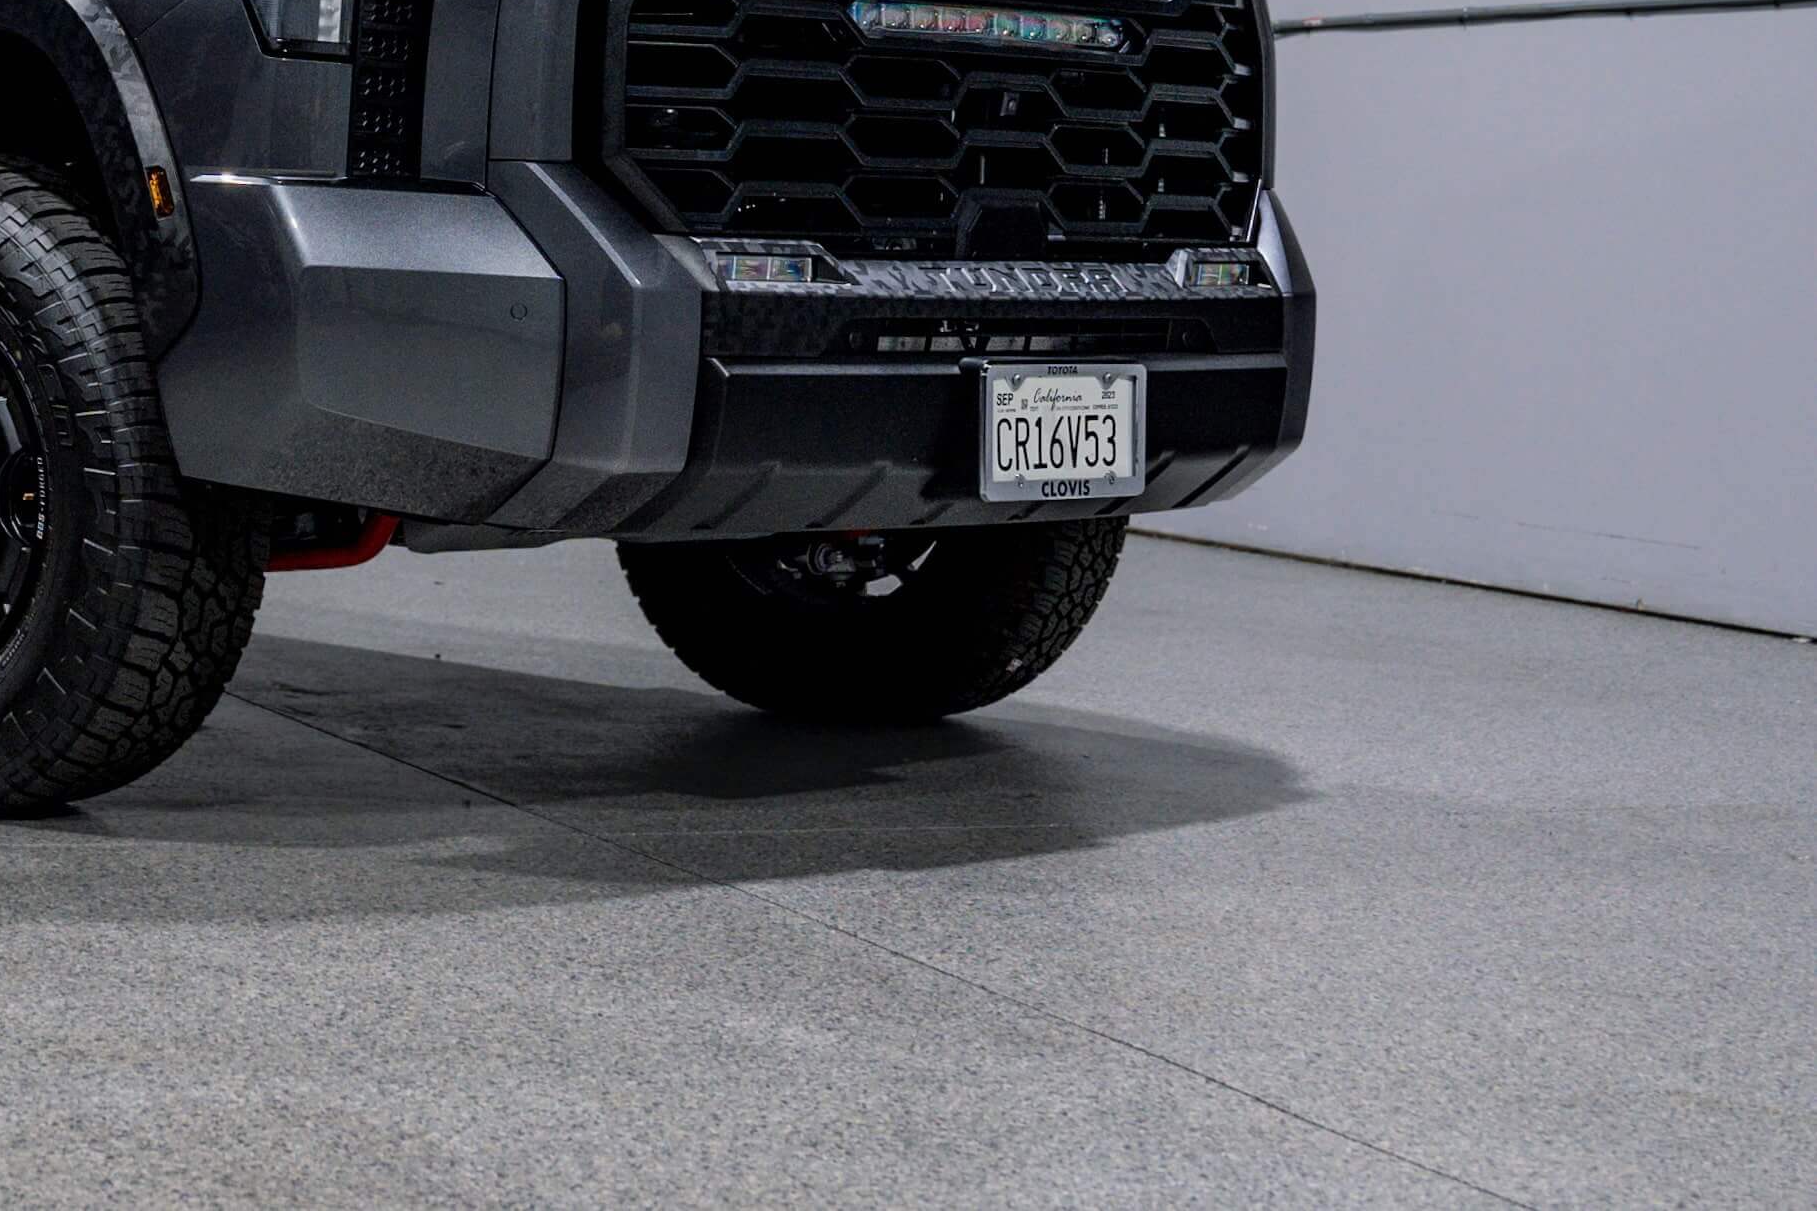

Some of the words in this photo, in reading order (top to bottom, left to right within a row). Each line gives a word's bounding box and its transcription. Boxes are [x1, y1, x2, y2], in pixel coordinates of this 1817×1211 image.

[1048, 366, 1078, 375] TOYOTA
[996, 393, 1014, 406] SEP
[1033, 388, 1083, 411] California
[997, 415, 1116, 471] CR16V53
[1041, 480, 1091, 497] CLOVIS
